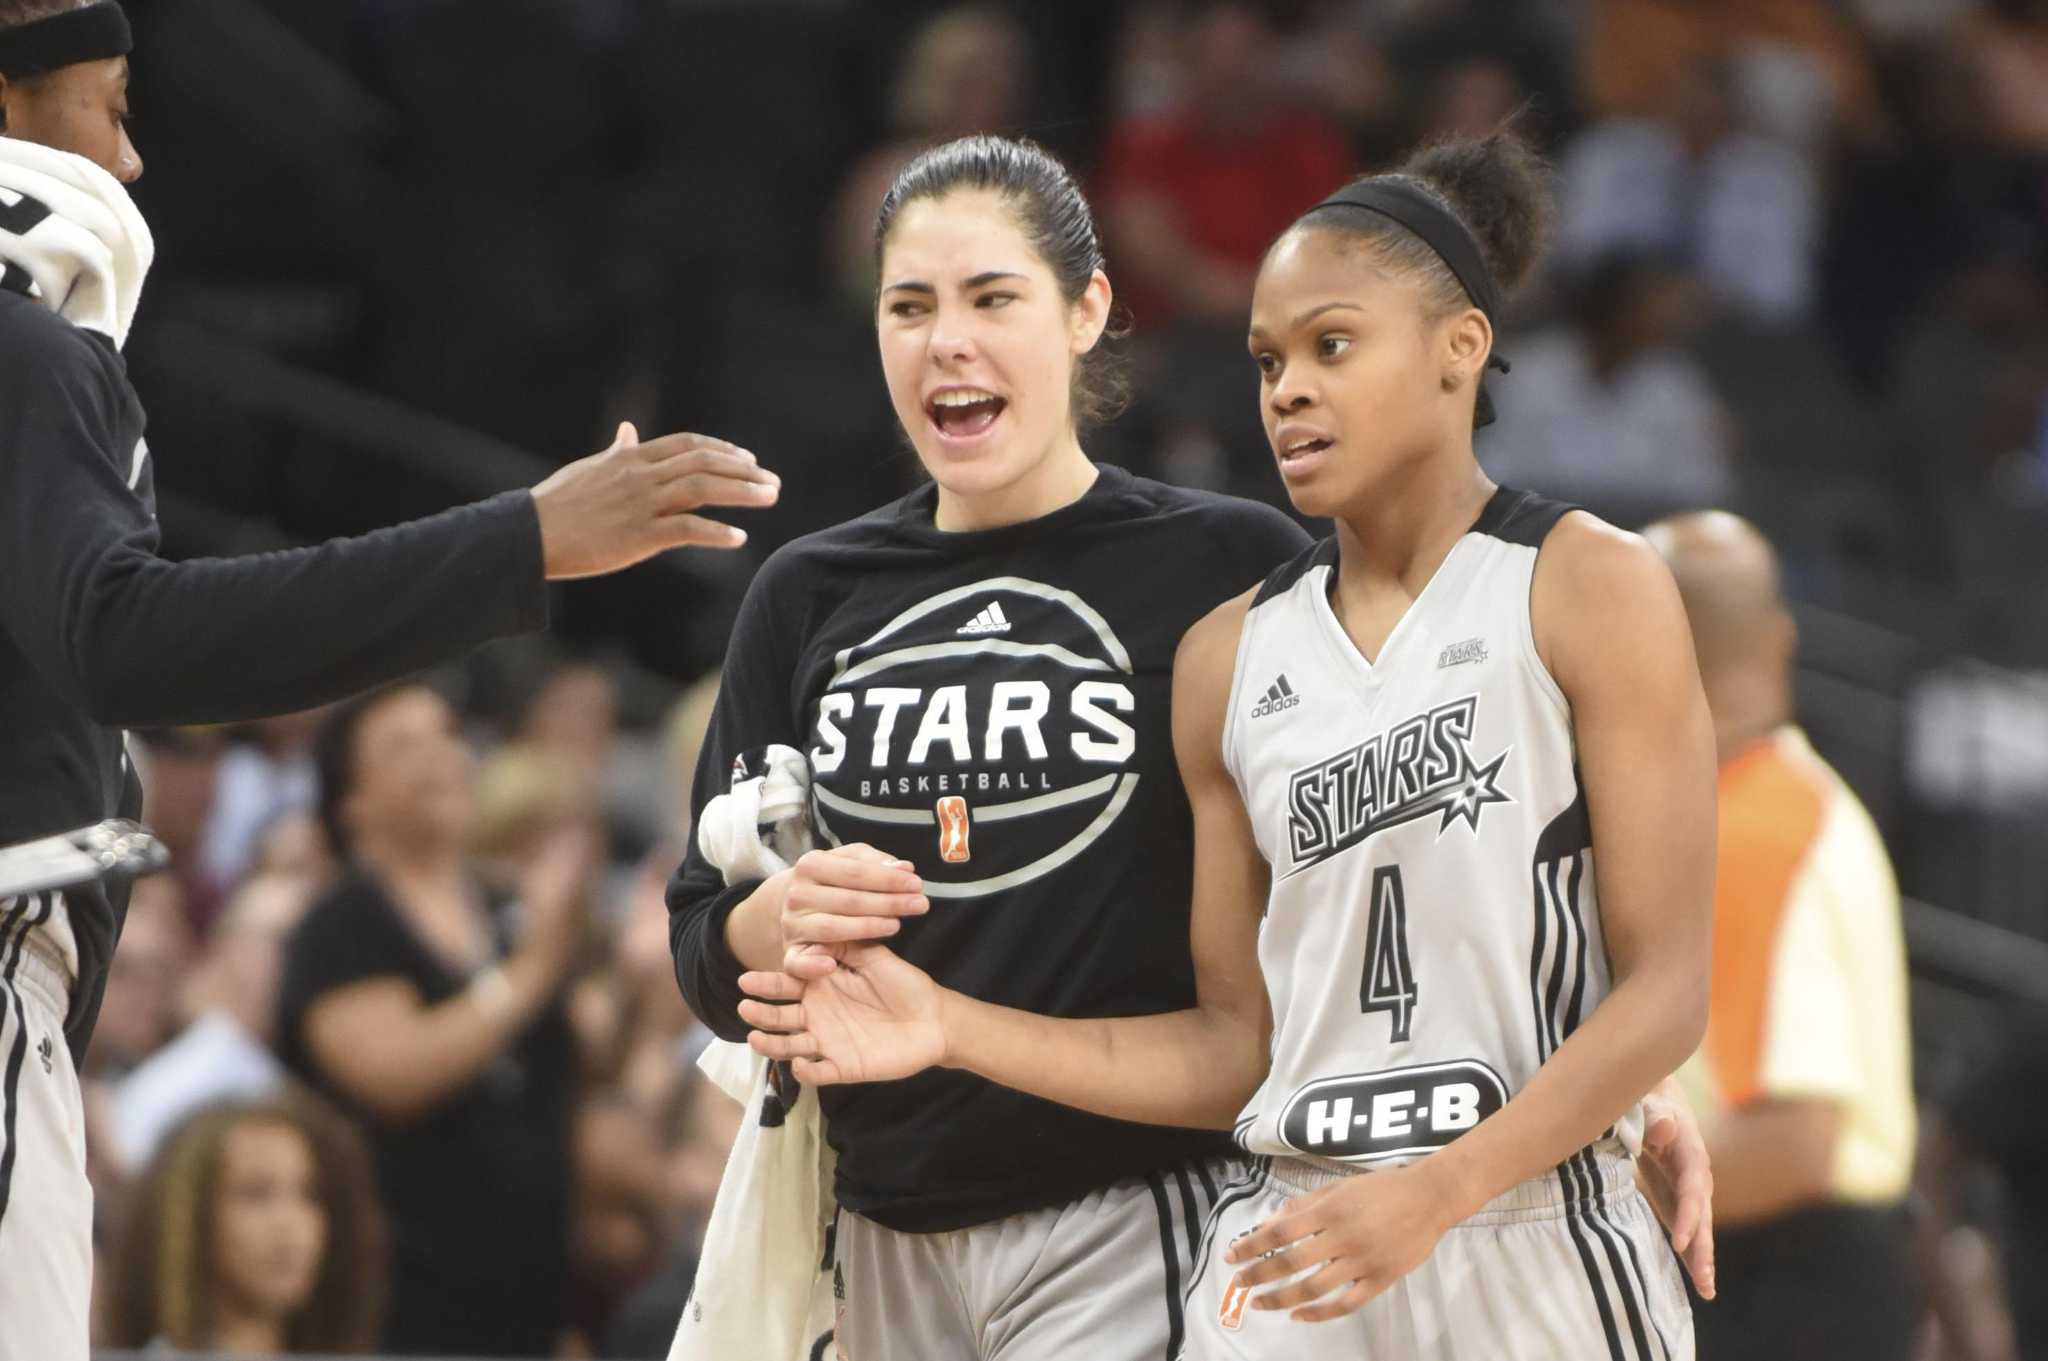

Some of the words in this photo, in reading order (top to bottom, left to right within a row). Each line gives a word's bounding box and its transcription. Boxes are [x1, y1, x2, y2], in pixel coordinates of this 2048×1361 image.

[810, 680, 1136, 773] STARS
[1251, 694, 1300, 719] adidas
[860, 772, 1051, 797] BASKETBALL
[1288, 694, 1478, 864] STARS
[1360, 864, 1418, 1044] 4
[1306, 1082, 1481, 1145] H-E-B
